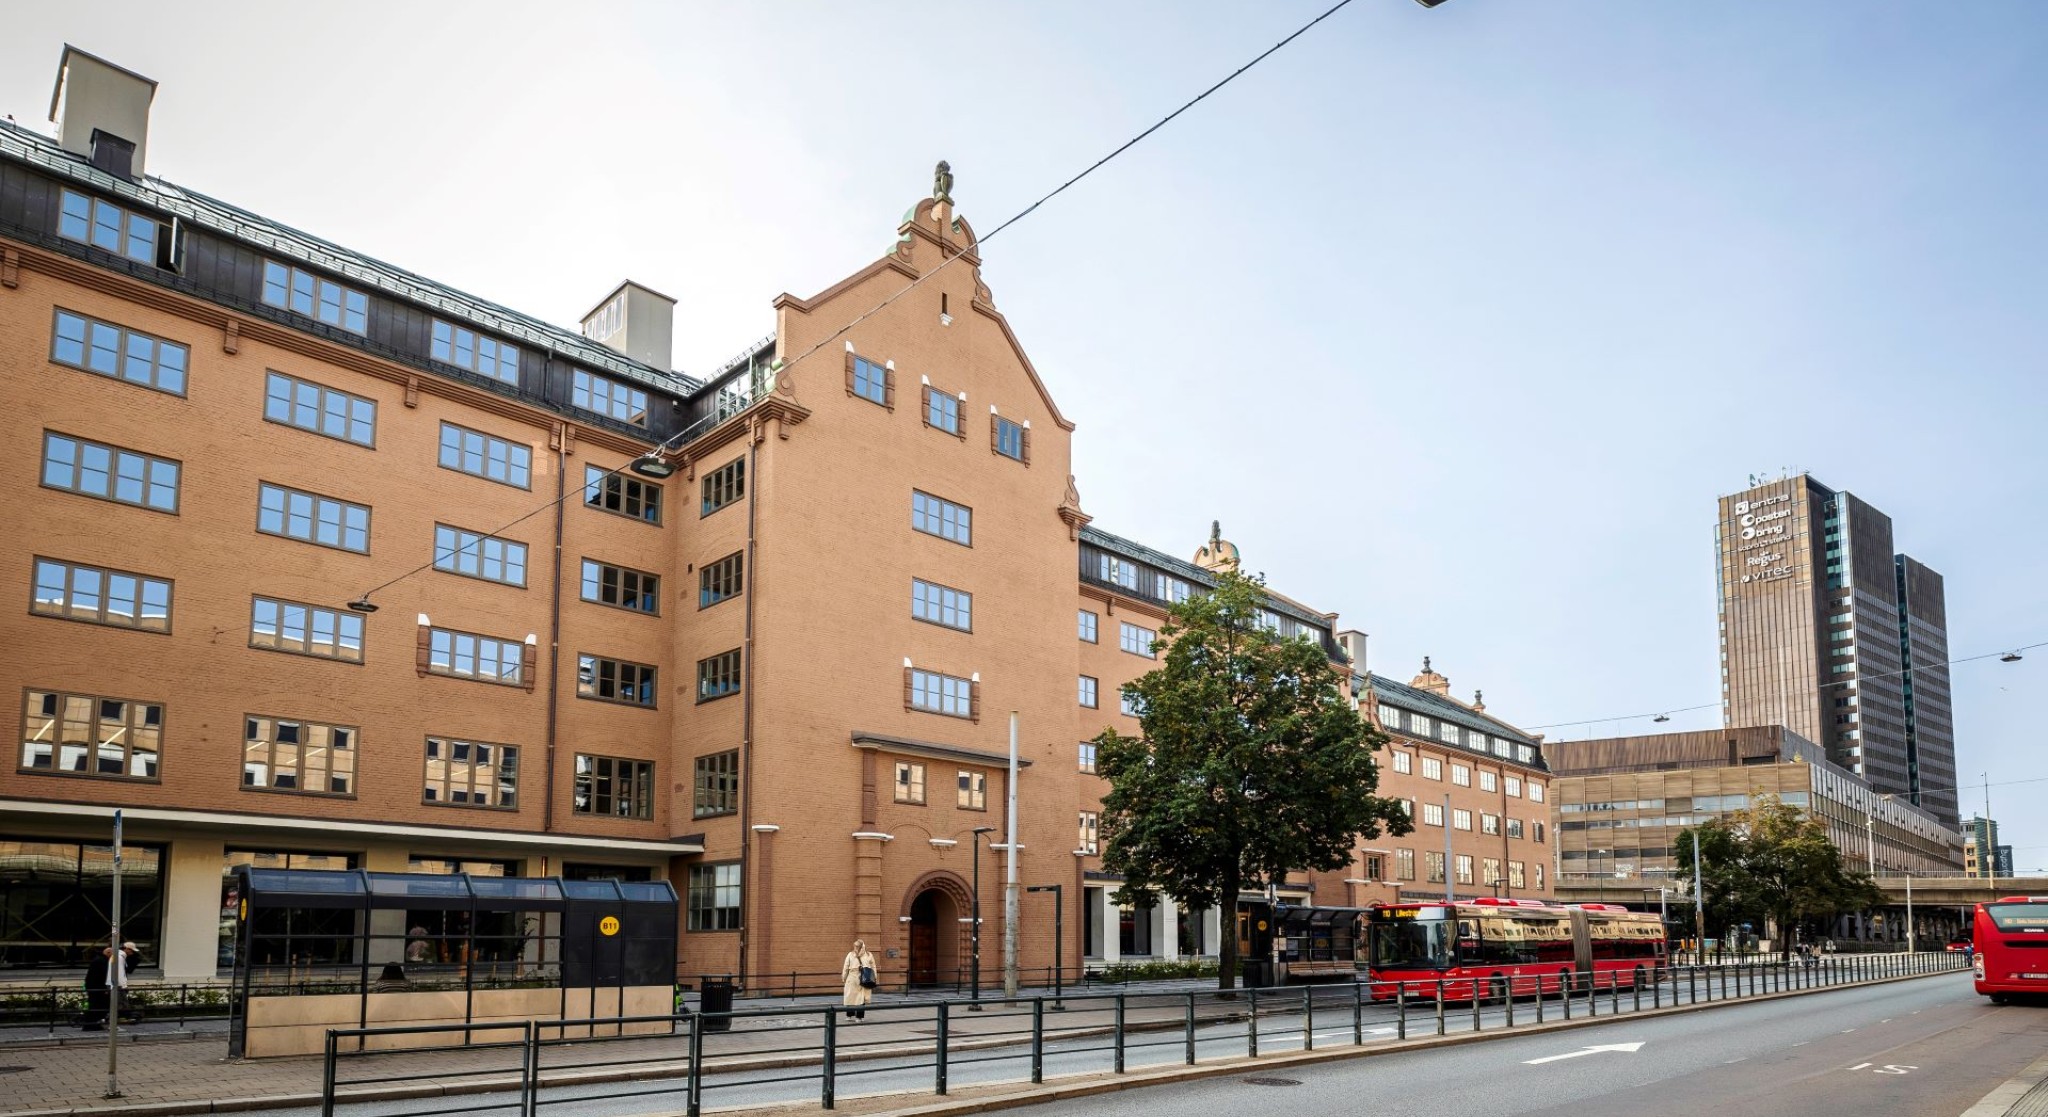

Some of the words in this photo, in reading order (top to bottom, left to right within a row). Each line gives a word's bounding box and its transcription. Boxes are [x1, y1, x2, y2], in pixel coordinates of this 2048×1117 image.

[1750, 494, 1789, 509] entra
[1756, 509, 1791, 525] posten
[1756, 525, 1783, 537] bring
[1747, 553, 1782, 567] Regus
[603, 922, 617, 930] B11
